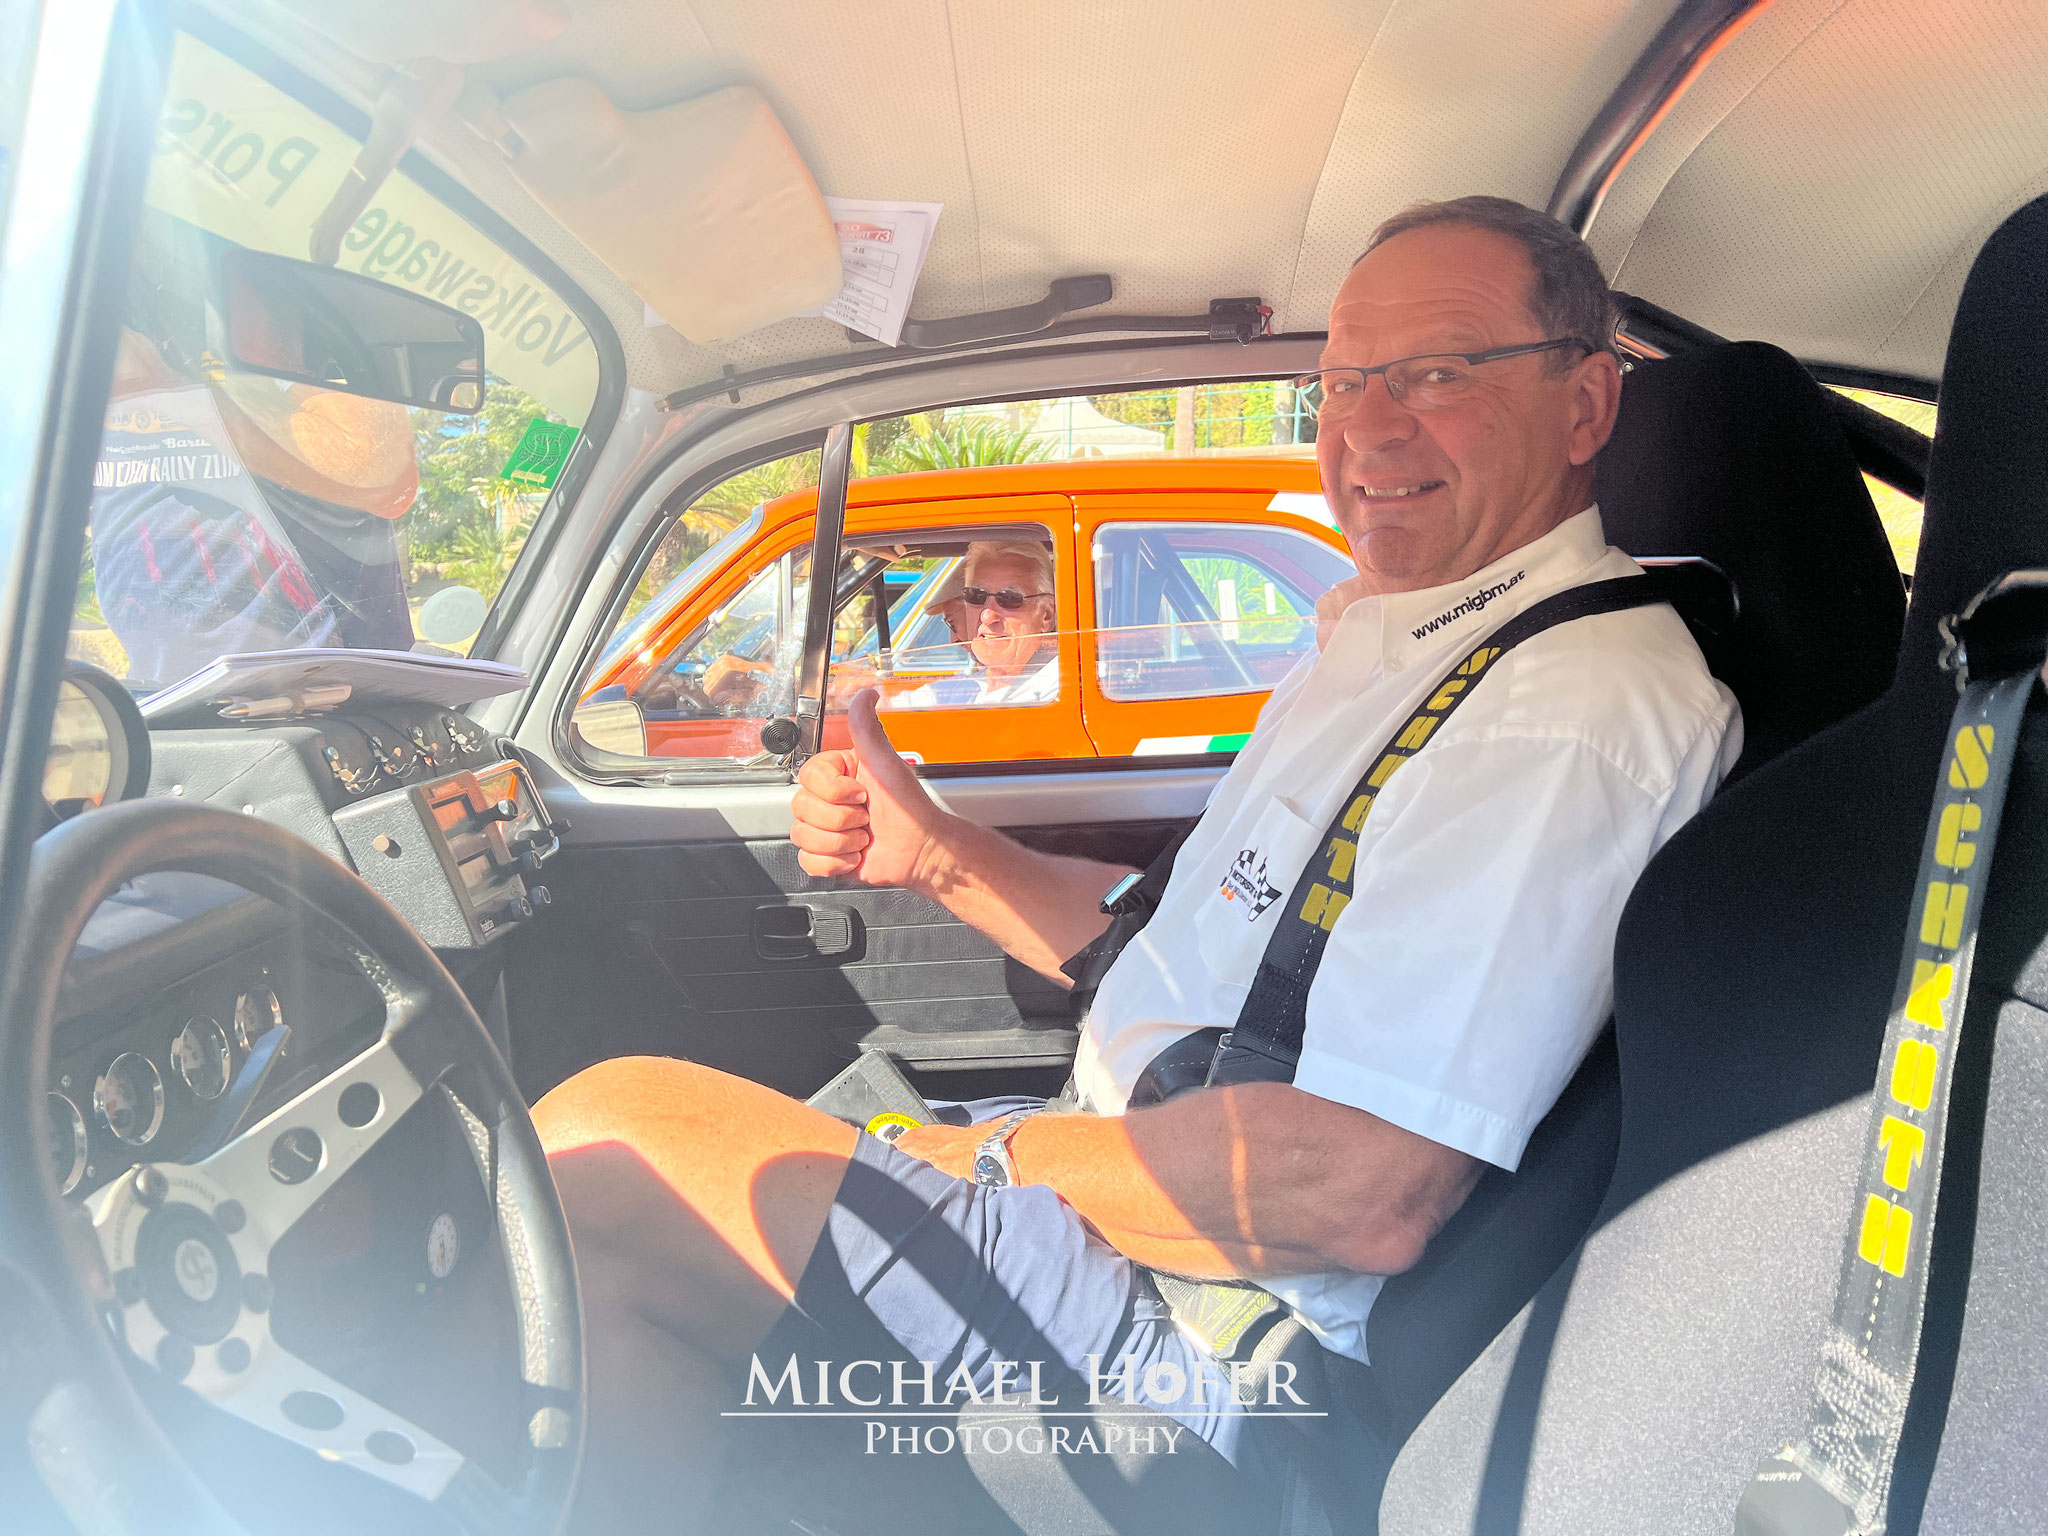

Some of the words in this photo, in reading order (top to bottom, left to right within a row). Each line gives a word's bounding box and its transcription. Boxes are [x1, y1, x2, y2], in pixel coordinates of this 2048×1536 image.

[874, 230, 892, 242] 73
[1410, 569, 1526, 642] www.migbm.at
[1858, 723, 1996, 1278] SCHROTH
